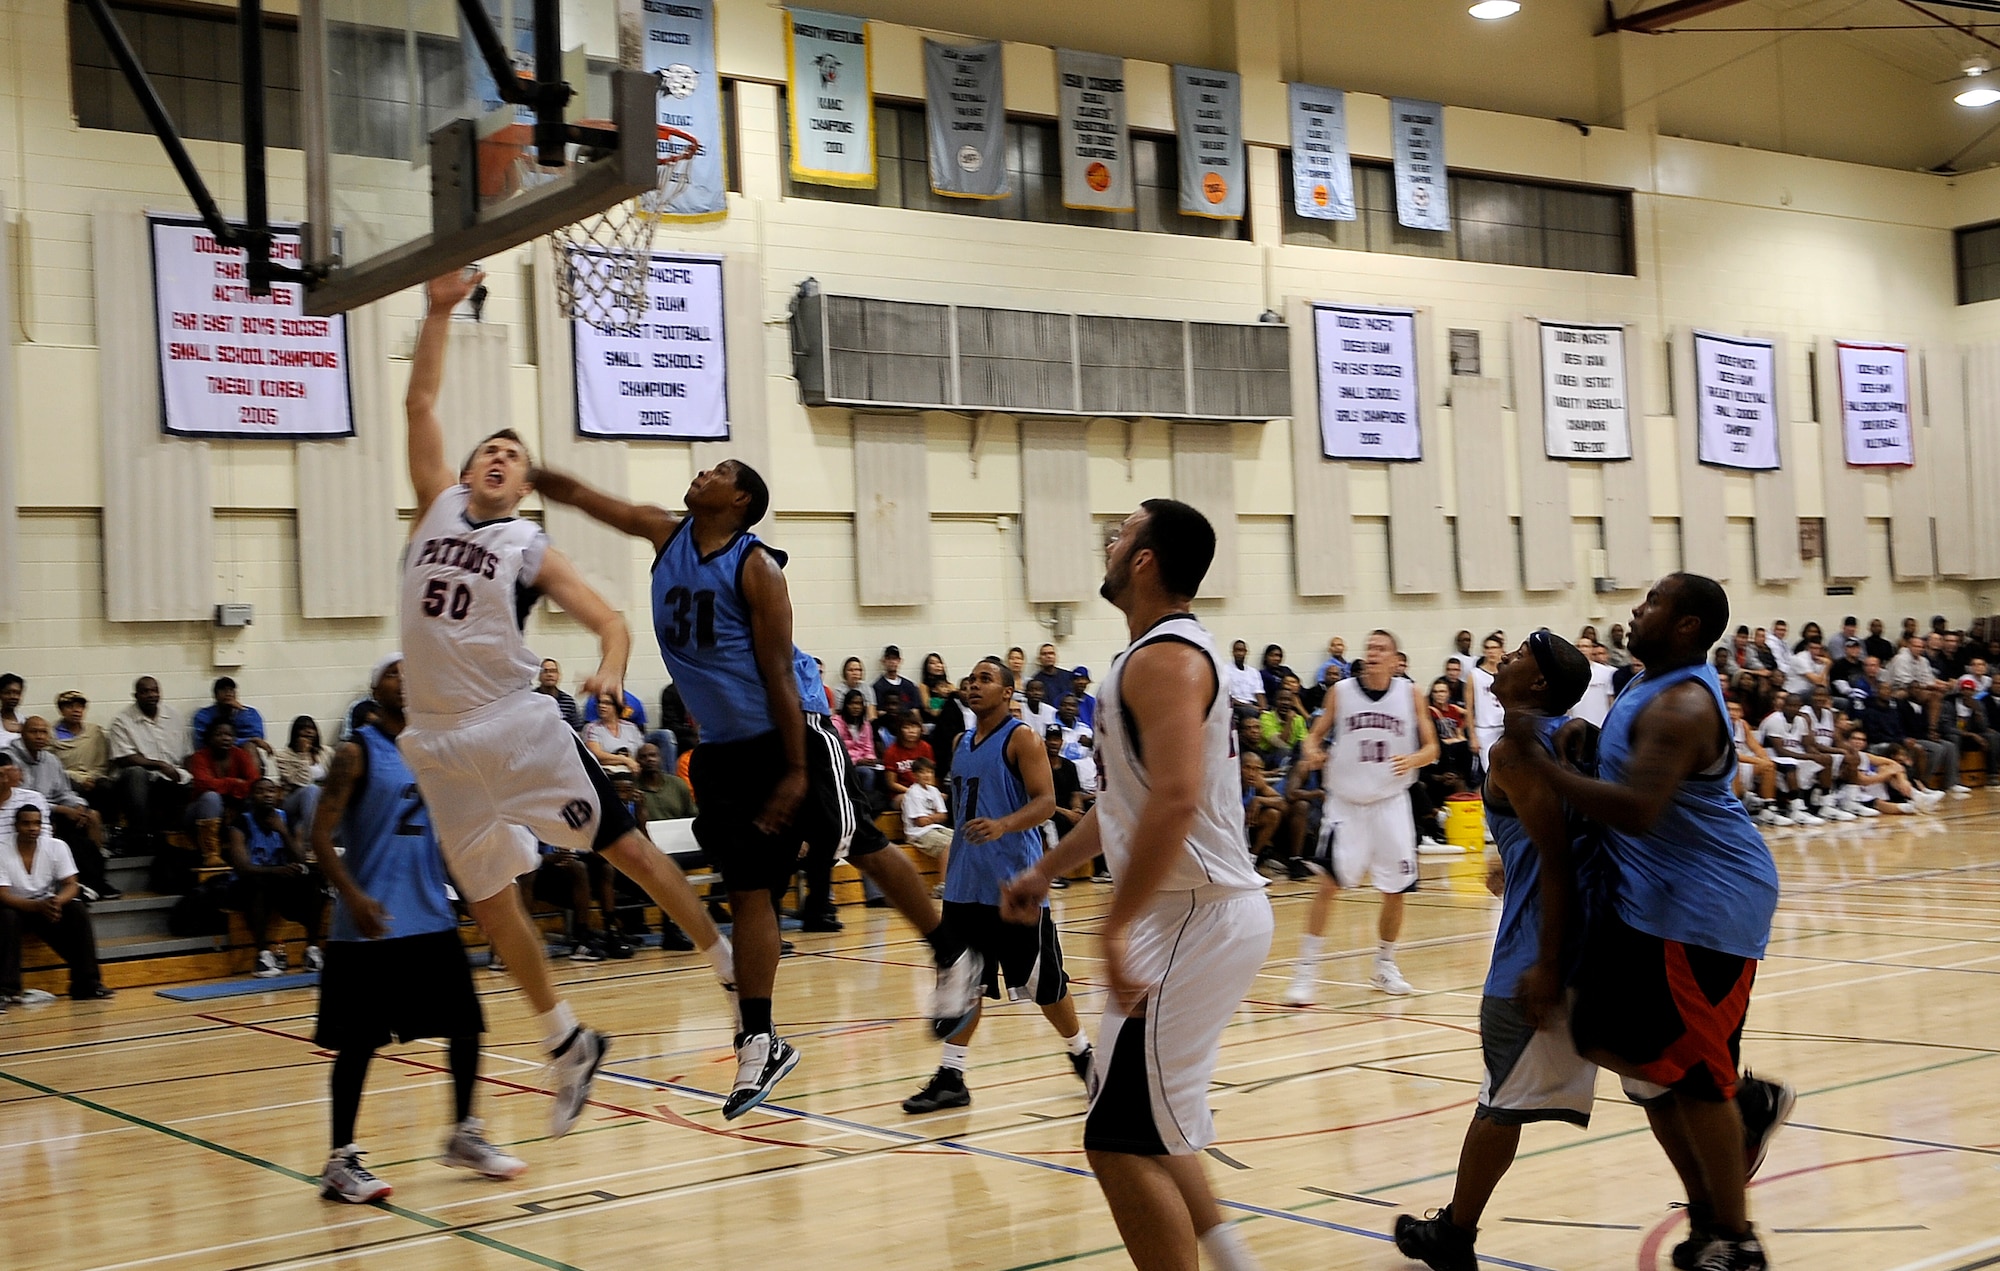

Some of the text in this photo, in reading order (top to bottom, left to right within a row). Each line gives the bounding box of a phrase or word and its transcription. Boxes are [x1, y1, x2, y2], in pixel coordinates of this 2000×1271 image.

[214, 261, 244, 279] FAR
[648, 267, 693, 285] PACIFIC
[213, 283, 293, 306] ACTIIES
[655, 296, 688, 313] GUAM
[172, 311, 330, 337] FAR EAST BOYS SOCCER
[654, 323, 713, 342] FOOTBALL
[169, 342, 338, 369] SMALL SCHOOL CHAMPIONS
[604, 351, 705, 370] SMALL SCHOOLS
[207, 376, 307, 399] TAEGU KOREA
[620, 380, 687, 398] CHAMPIONS
[239, 406, 279, 425] 2005
[639, 410, 672, 426] 2005
[422, 578, 472, 620] 50
[664, 585, 717, 650] 31
